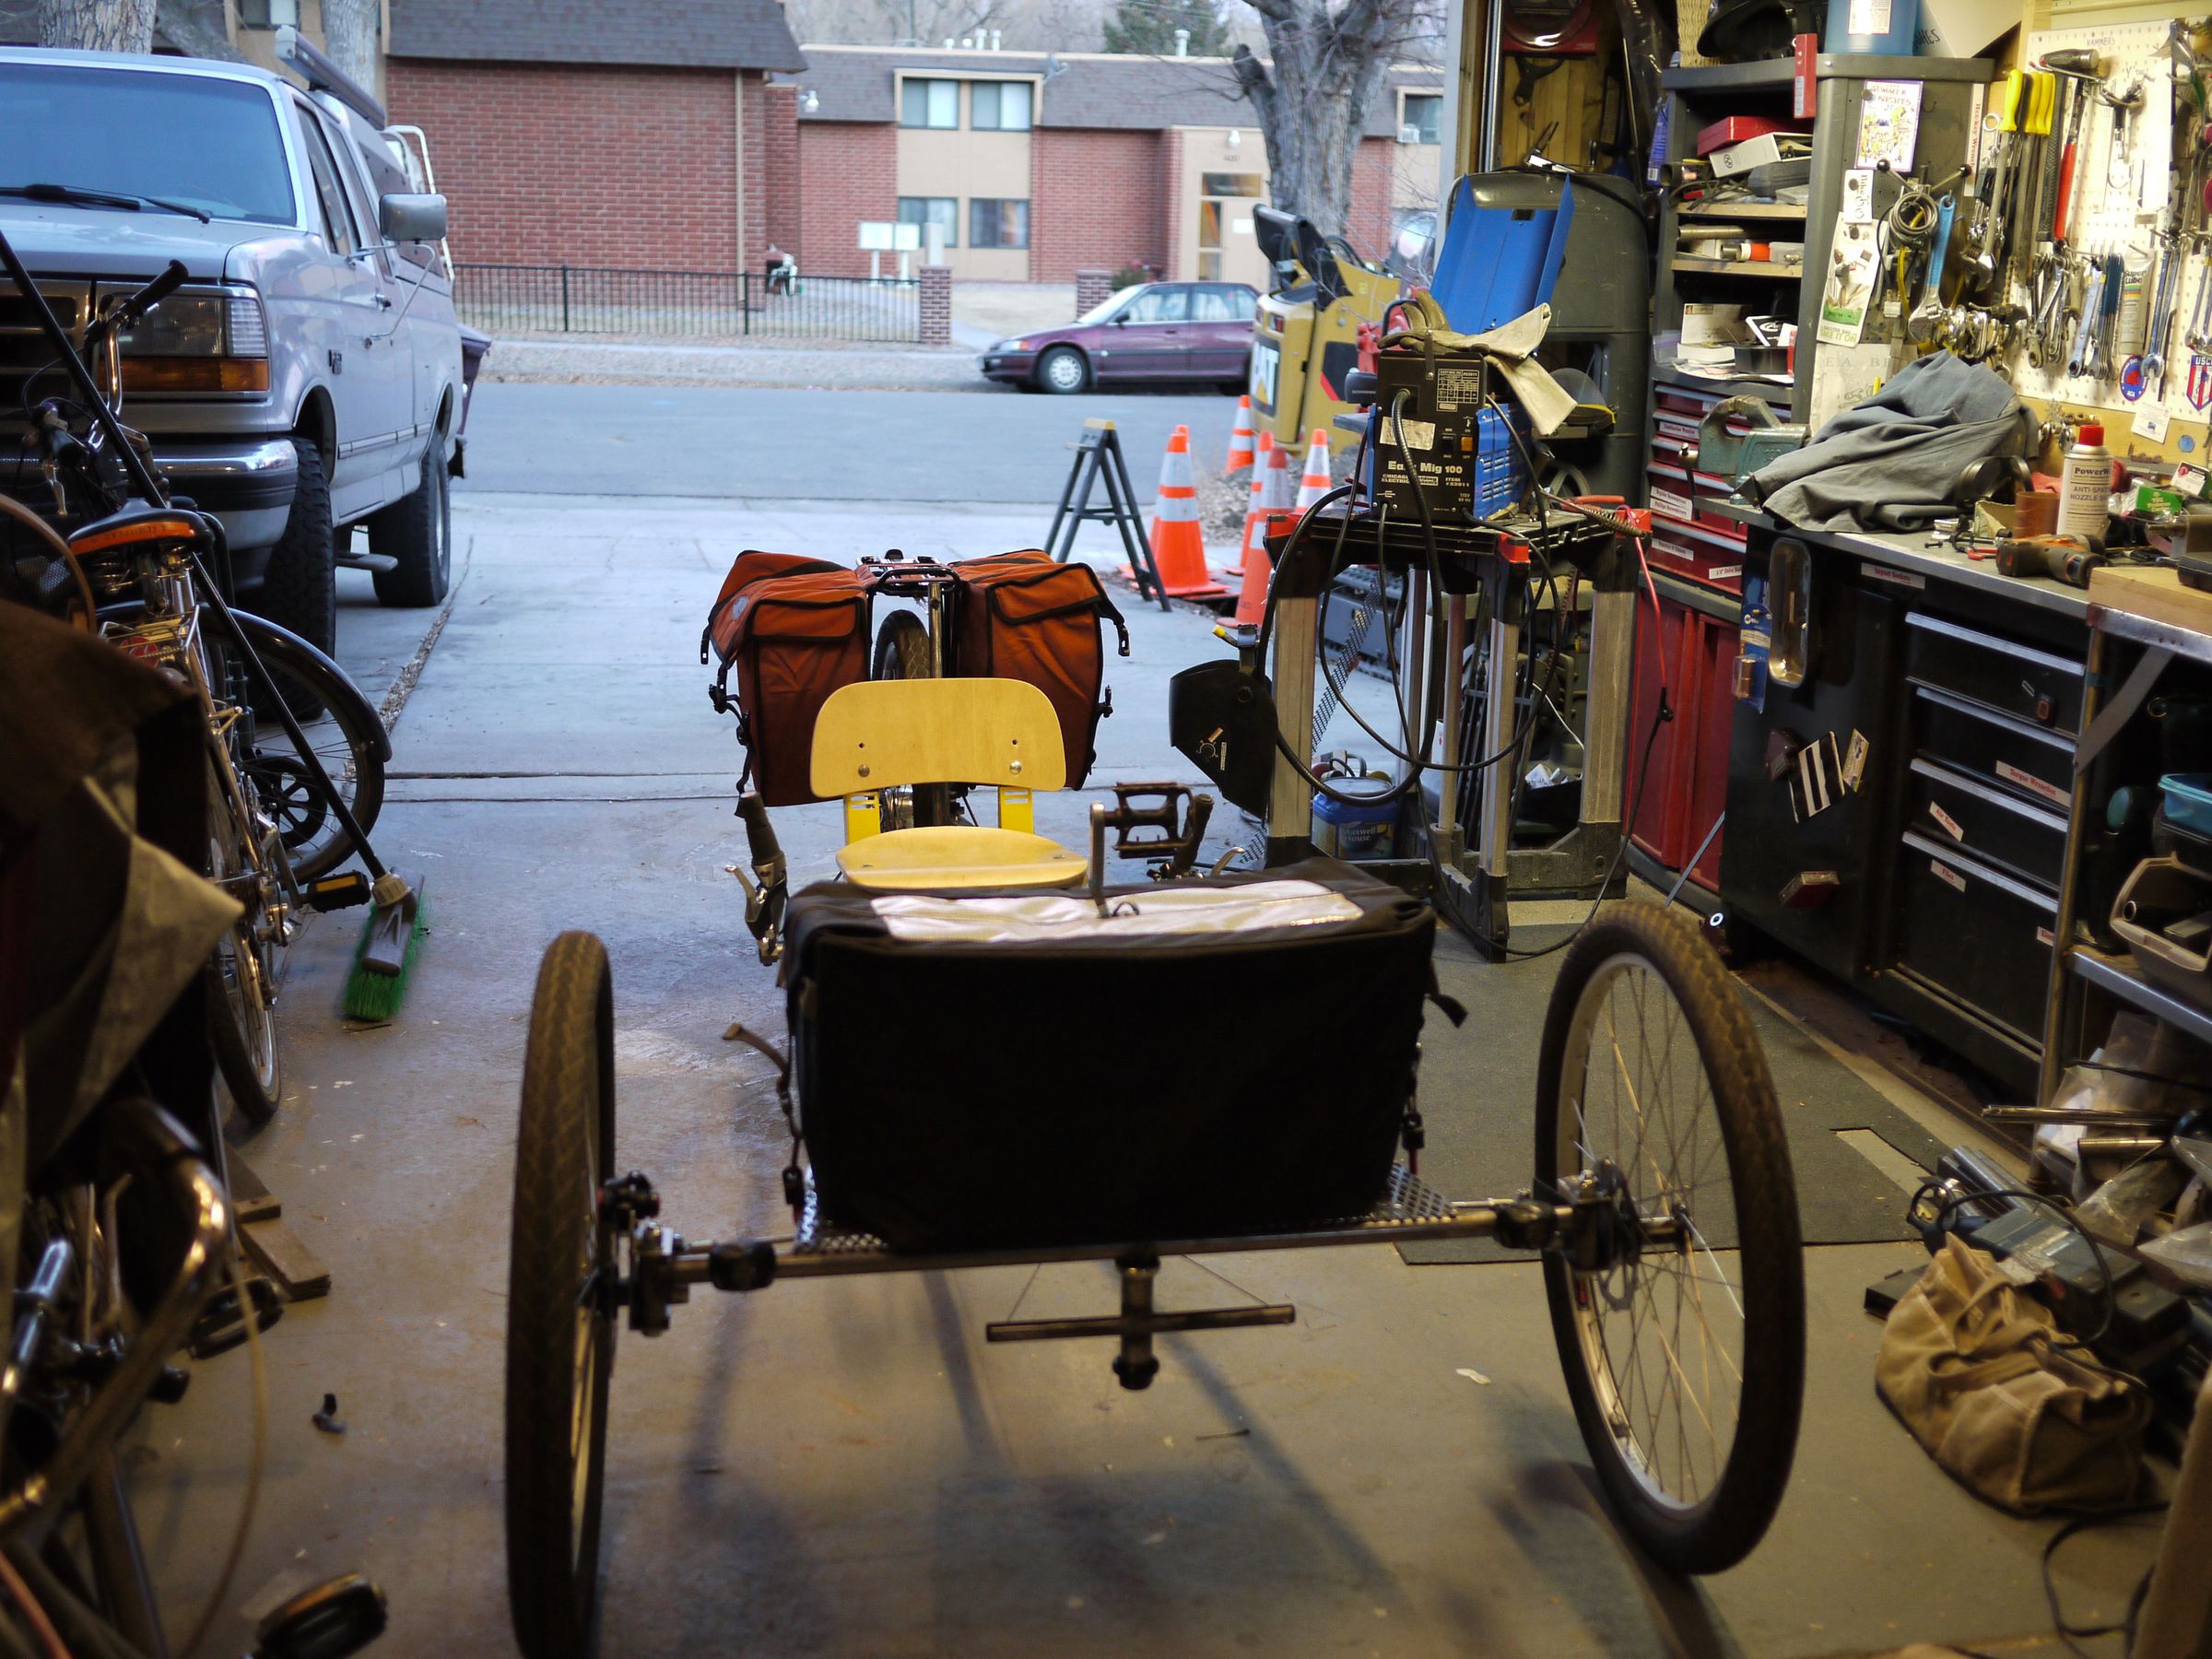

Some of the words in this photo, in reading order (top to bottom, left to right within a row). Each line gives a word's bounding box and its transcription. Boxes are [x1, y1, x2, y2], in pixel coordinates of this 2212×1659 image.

[1420, 463, 1442, 474] Mig
[1445, 465, 1464, 474] 100
[2009, 768, 2029, 782] Torque
[2030, 777, 2056, 795] Wrenches
[1936, 808, 1944, 818] Air
[1945, 814, 1957, 830] Tools
[1342, 826, 1376, 834] Maxwell
[1941, 868, 1954, 880] Files
